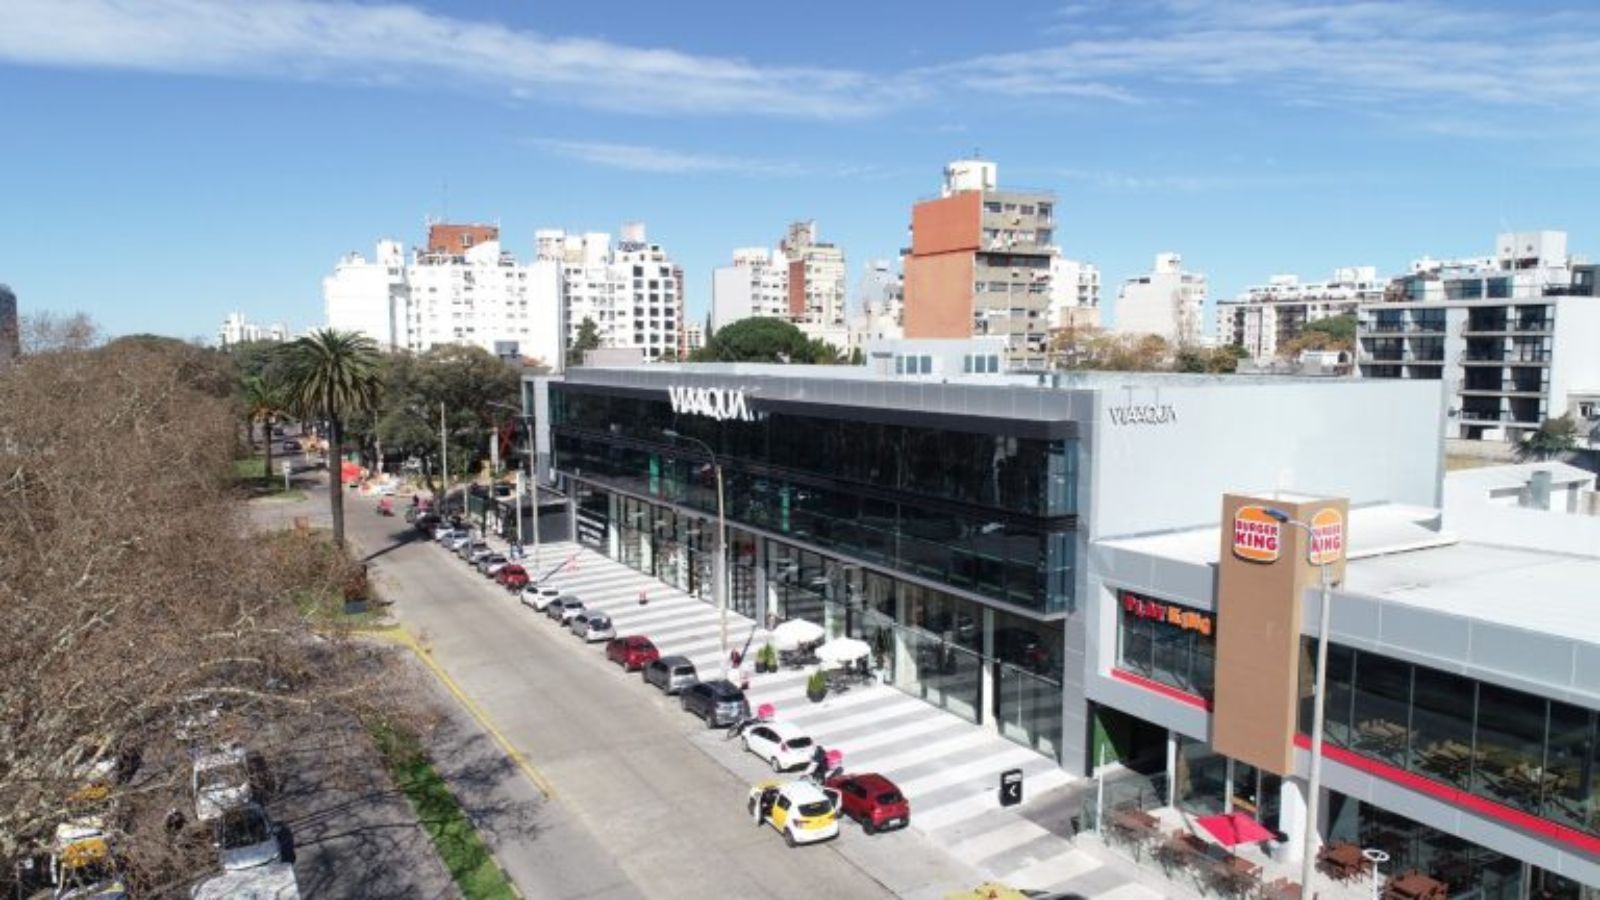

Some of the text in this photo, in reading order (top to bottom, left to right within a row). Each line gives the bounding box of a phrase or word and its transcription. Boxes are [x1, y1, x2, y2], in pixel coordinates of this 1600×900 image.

[1236, 520, 1278, 536] BURGER
[1235, 532, 1278, 551] KING
[1312, 538, 1341, 552] KING
